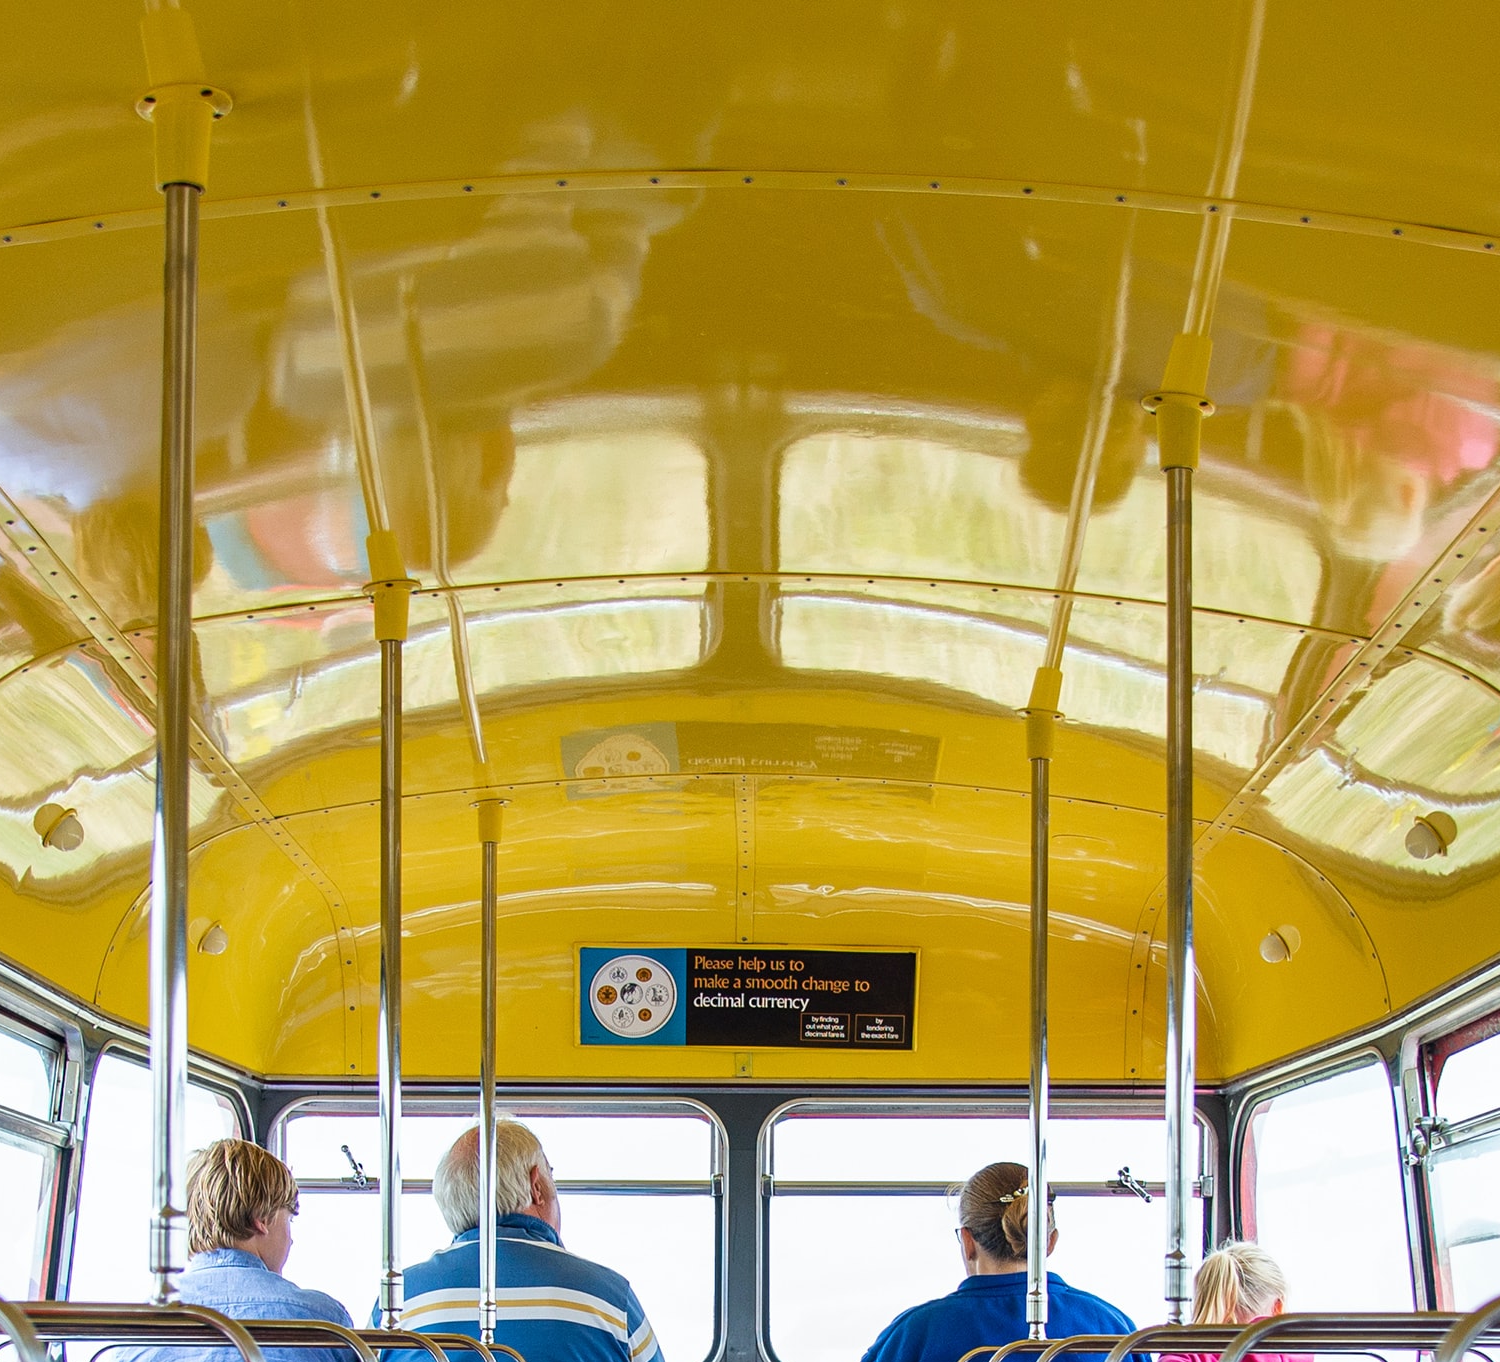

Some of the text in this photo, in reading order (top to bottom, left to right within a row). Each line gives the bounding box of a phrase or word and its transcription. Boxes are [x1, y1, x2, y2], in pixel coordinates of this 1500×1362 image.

[693, 955, 805, 973] Please help us to
[693, 973, 870, 994] make a smooth change to
[693, 992, 810, 1012] decimal currency
[819, 1016, 839, 1024] finding
[875, 1017, 883, 1025] by
